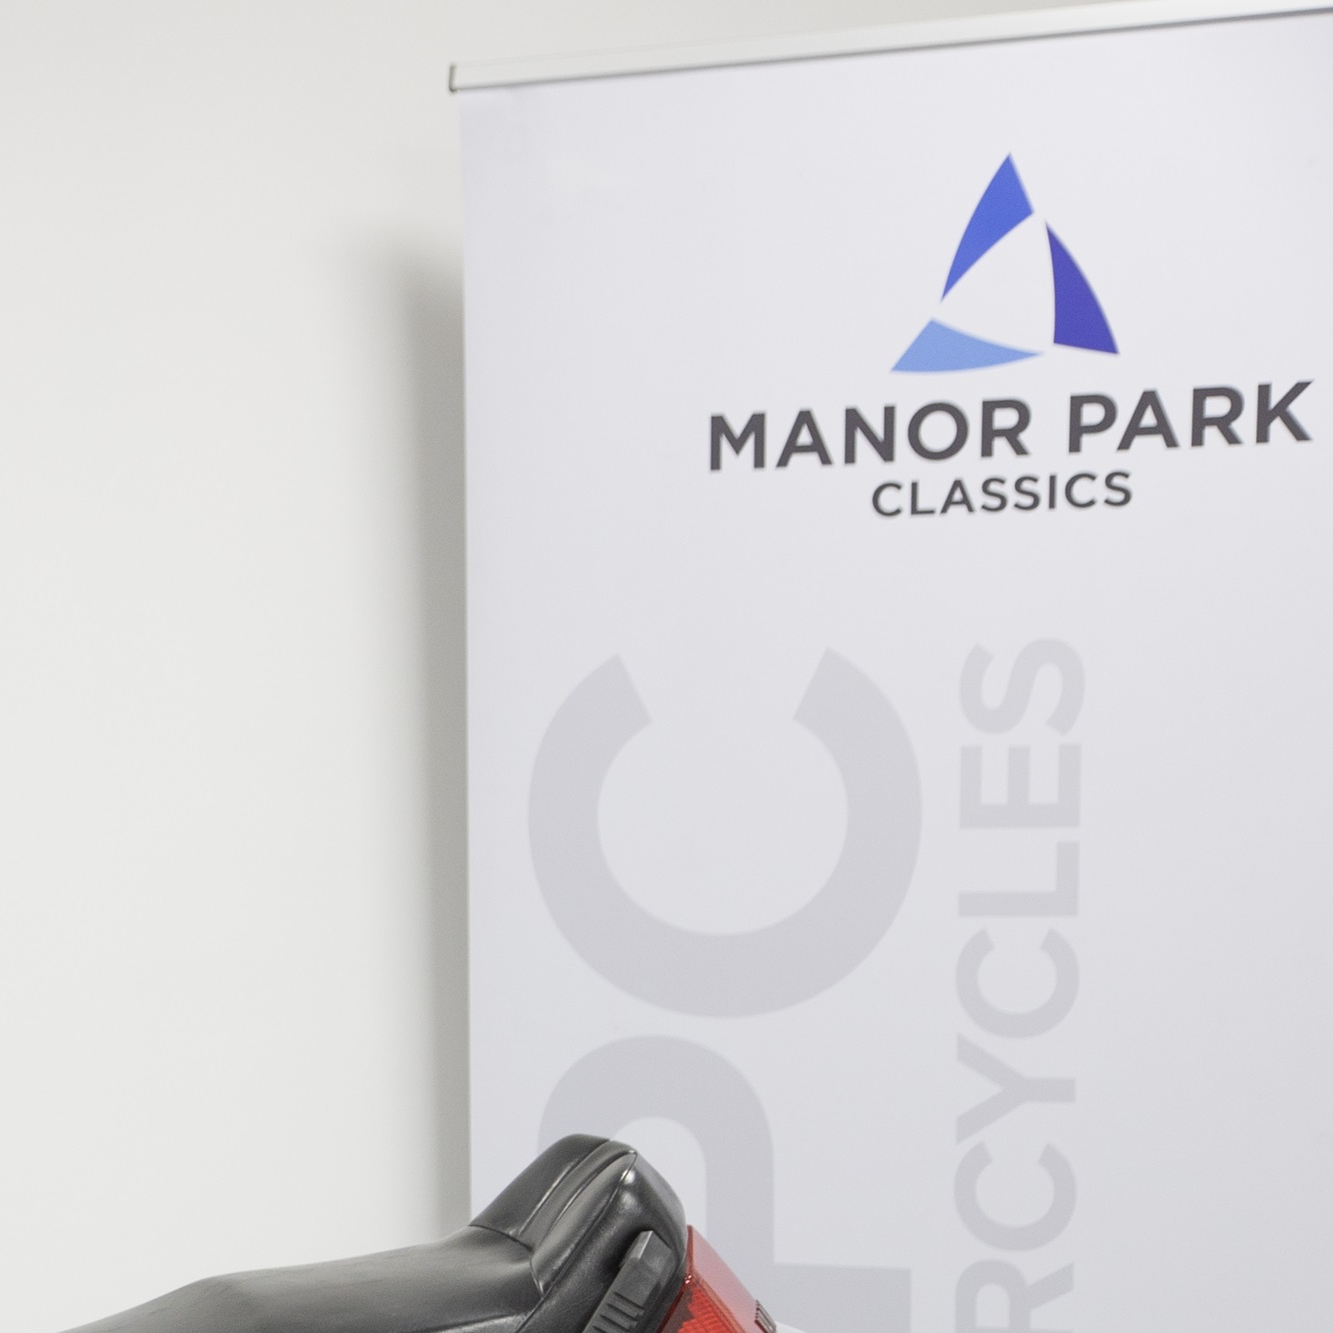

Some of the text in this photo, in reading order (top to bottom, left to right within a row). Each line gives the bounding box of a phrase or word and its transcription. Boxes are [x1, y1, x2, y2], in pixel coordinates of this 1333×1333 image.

[709, 379, 1312, 471] MANOR PARK
[871, 470, 1132, 517] CLASSICS
